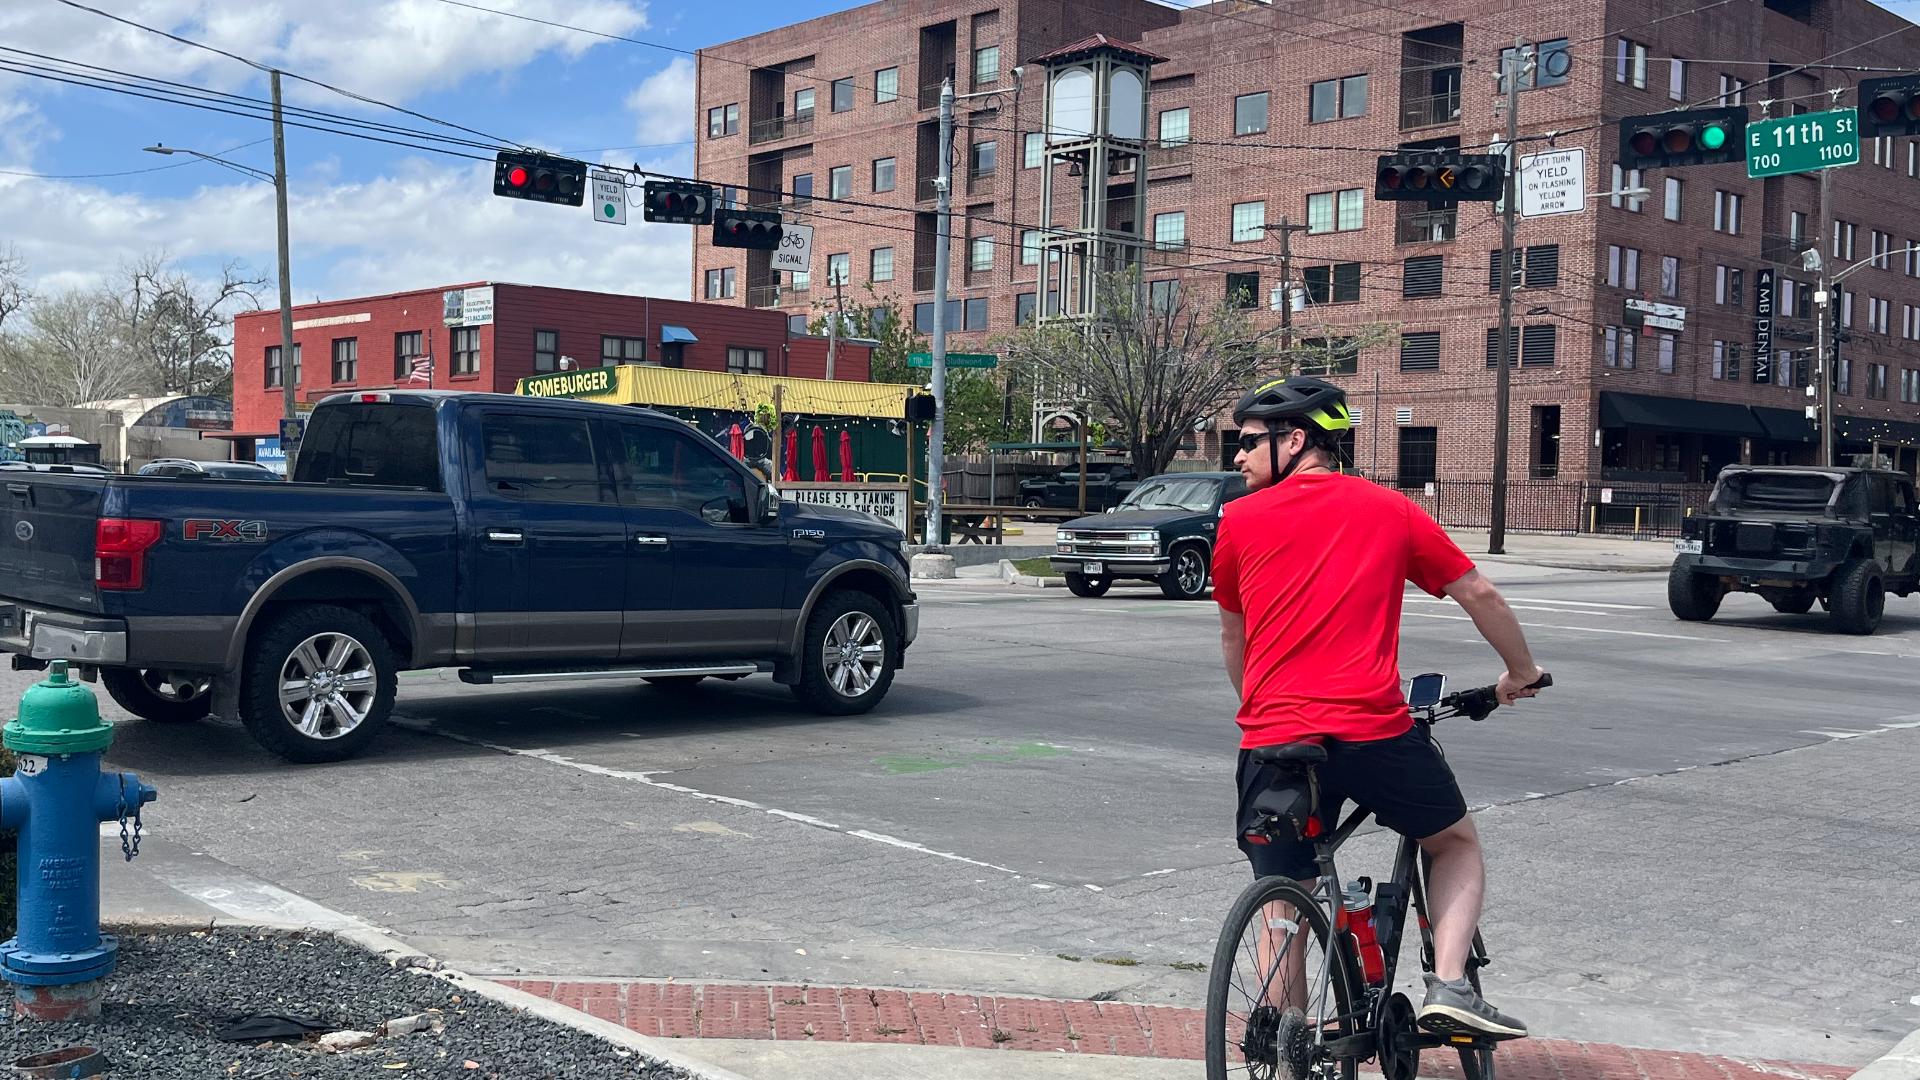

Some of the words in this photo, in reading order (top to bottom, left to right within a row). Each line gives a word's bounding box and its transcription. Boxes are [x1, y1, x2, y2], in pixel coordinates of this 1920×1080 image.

[1751, 133, 1761, 147] E
[1772, 121, 1823, 148] 11th
[1836, 118, 1853, 133] St
[1533, 157, 1549, 167] LEFT
[1552, 155, 1571, 165] TURN
[1752, 153, 1781, 170] 700
[1819, 143, 1853, 160] 1100
[1537, 166, 1568, 179] YIELD
[600, 183, 618, 194] YIELD
[1528, 183, 1539, 191] ON
[1541, 178, 1576, 189] FLASHING
[1539, 190, 1566, 200] YELLOW
[1540, 201, 1565, 211] ARROW
[778, 253, 803, 265] SIGNAL
[1759, 288, 1770, 313] MB
[1756, 319, 1769, 381] DENTAL
[528, 371, 608, 398] SOMEBURGER
[258, 447, 286, 458] AVAILABLE
[795, 491, 831, 504] PLEASE
[862, 492, 895, 505] TAKING
[183, 518, 268, 542] FX4
